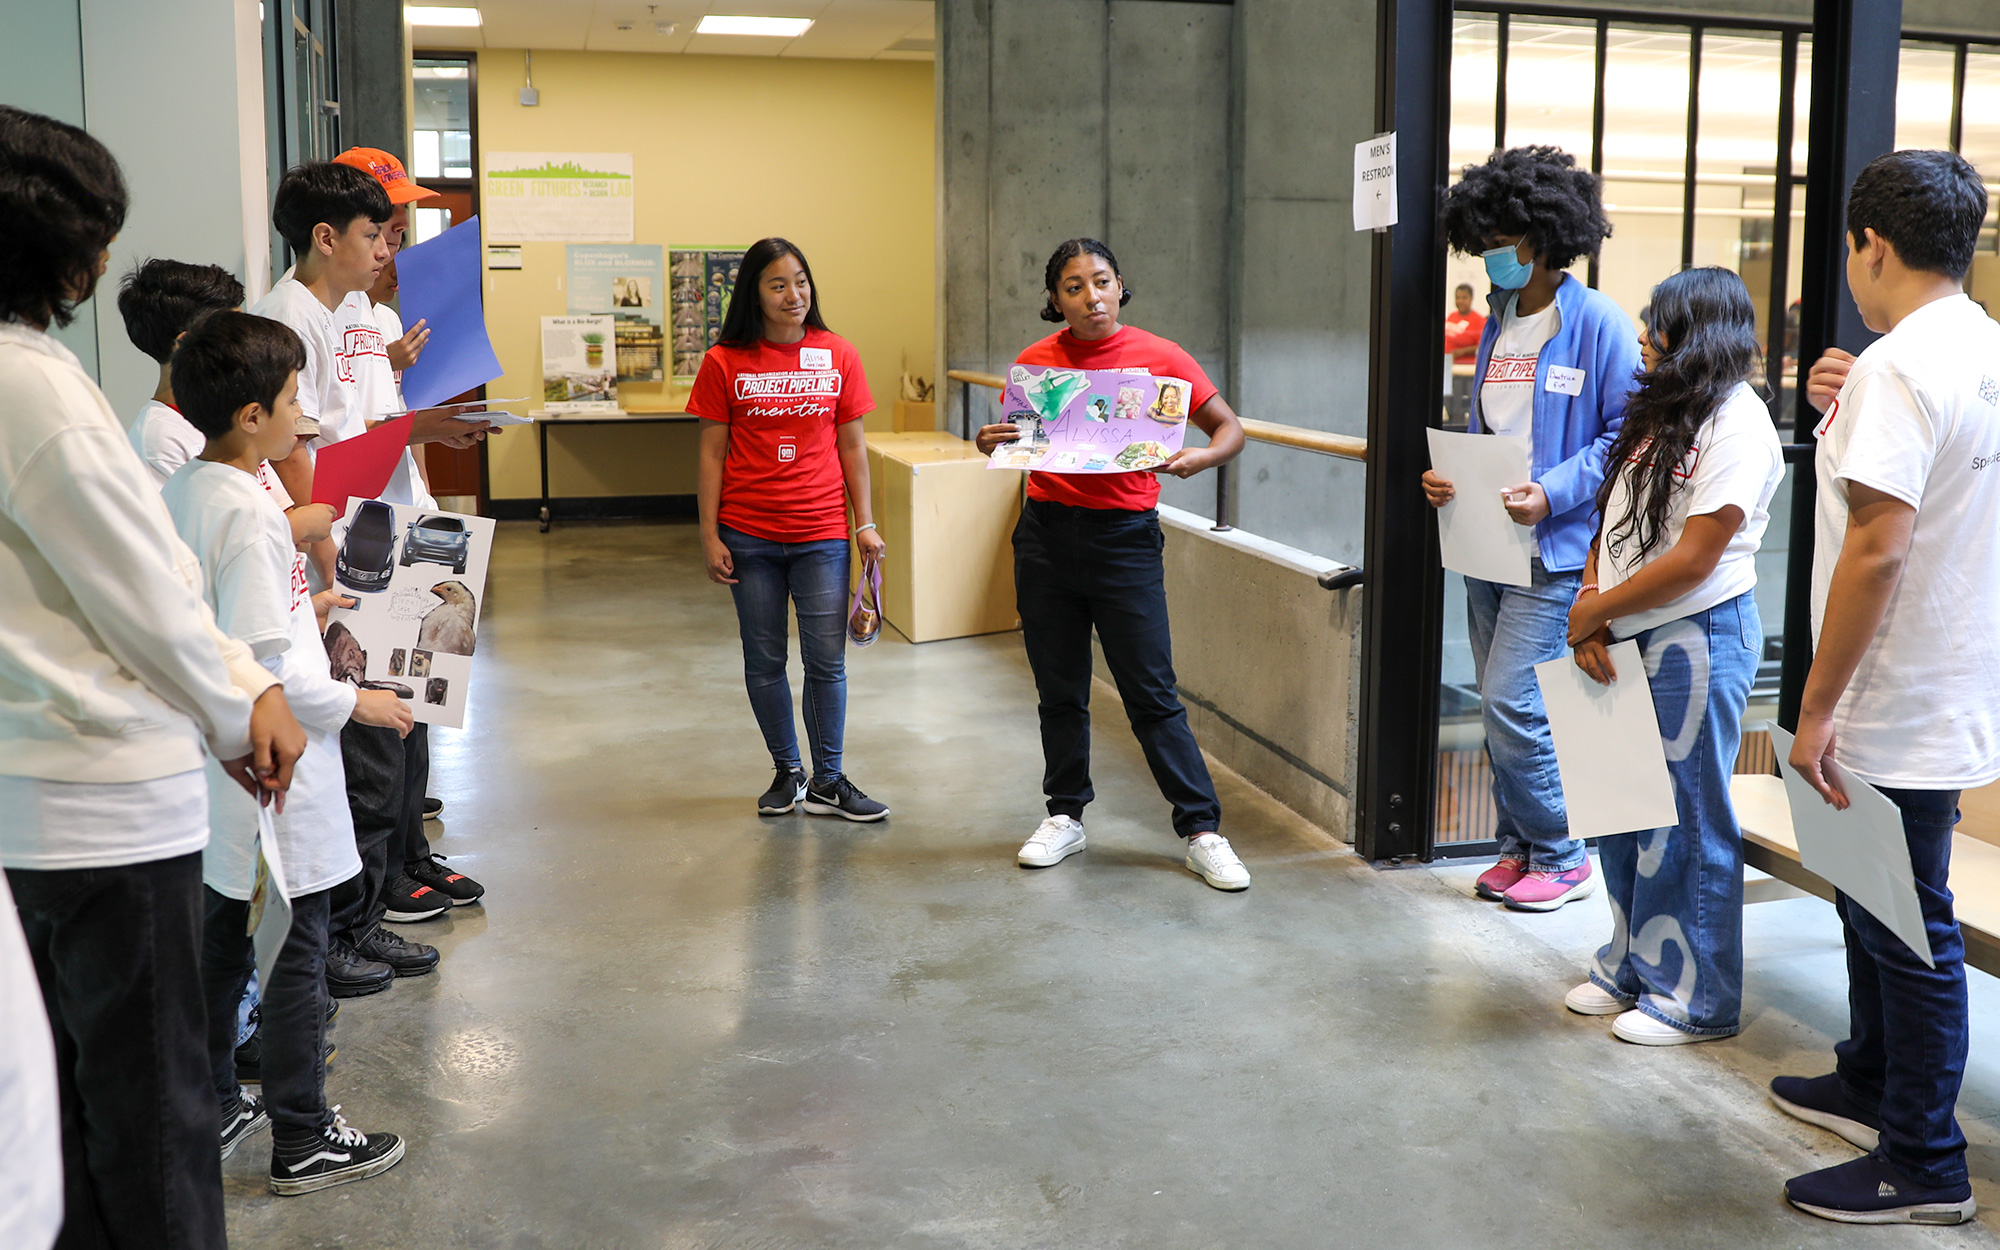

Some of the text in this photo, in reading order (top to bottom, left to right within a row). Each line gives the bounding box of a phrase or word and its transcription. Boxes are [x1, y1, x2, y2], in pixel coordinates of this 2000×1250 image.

[1370, 143, 1390, 158] MEN'S
[487, 180, 581, 197] GREEN FUTURES
[610, 180, 632, 198] LAB
[742, 377, 836, 394] PROJECT PIPELINE
[746, 400, 831, 417] mentor
[1048, 409, 1133, 443] ALYSSA
